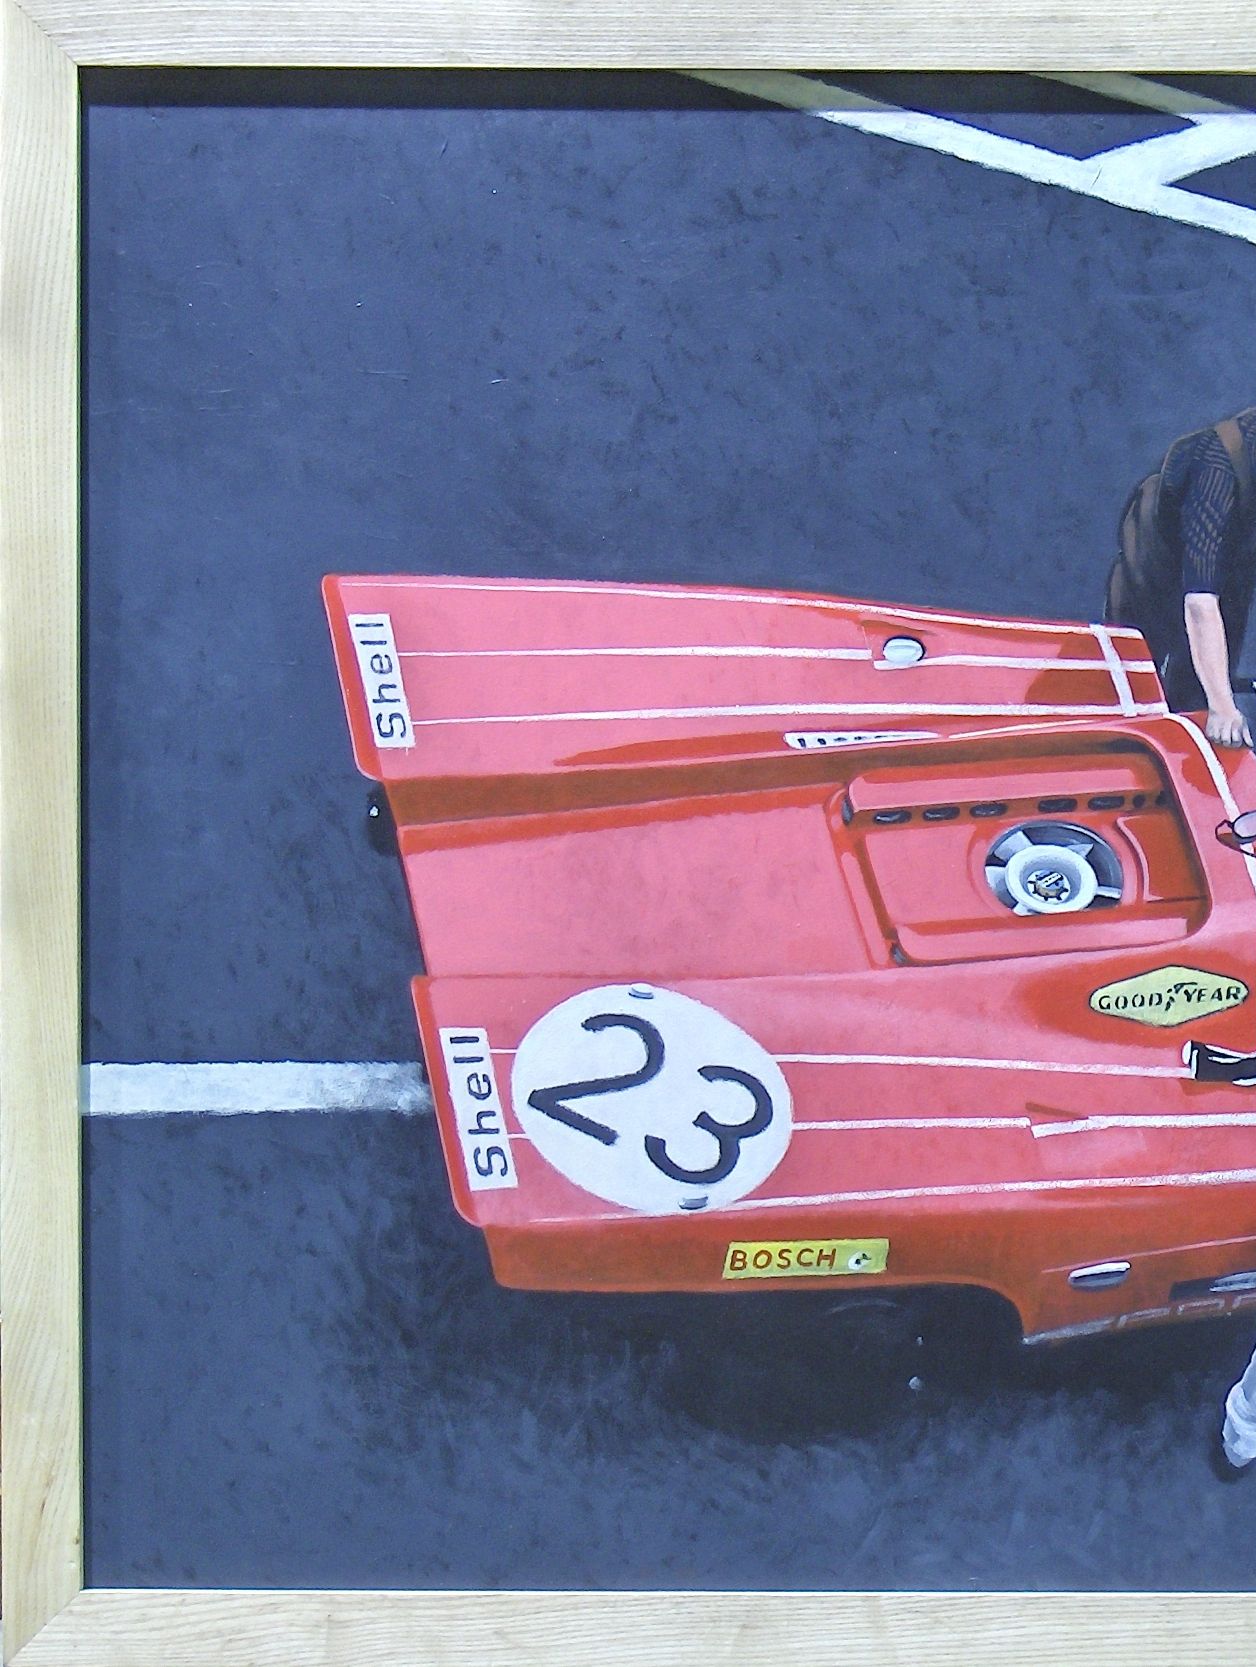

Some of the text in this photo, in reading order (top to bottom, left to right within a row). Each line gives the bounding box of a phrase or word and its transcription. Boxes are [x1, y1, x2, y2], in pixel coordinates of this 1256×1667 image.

[354, 622, 407, 739] Shell
[449, 1035, 509, 1178] Shell
[527, 1012, 774, 1185] 23
[728, 1247, 838, 1272] BOSCH
